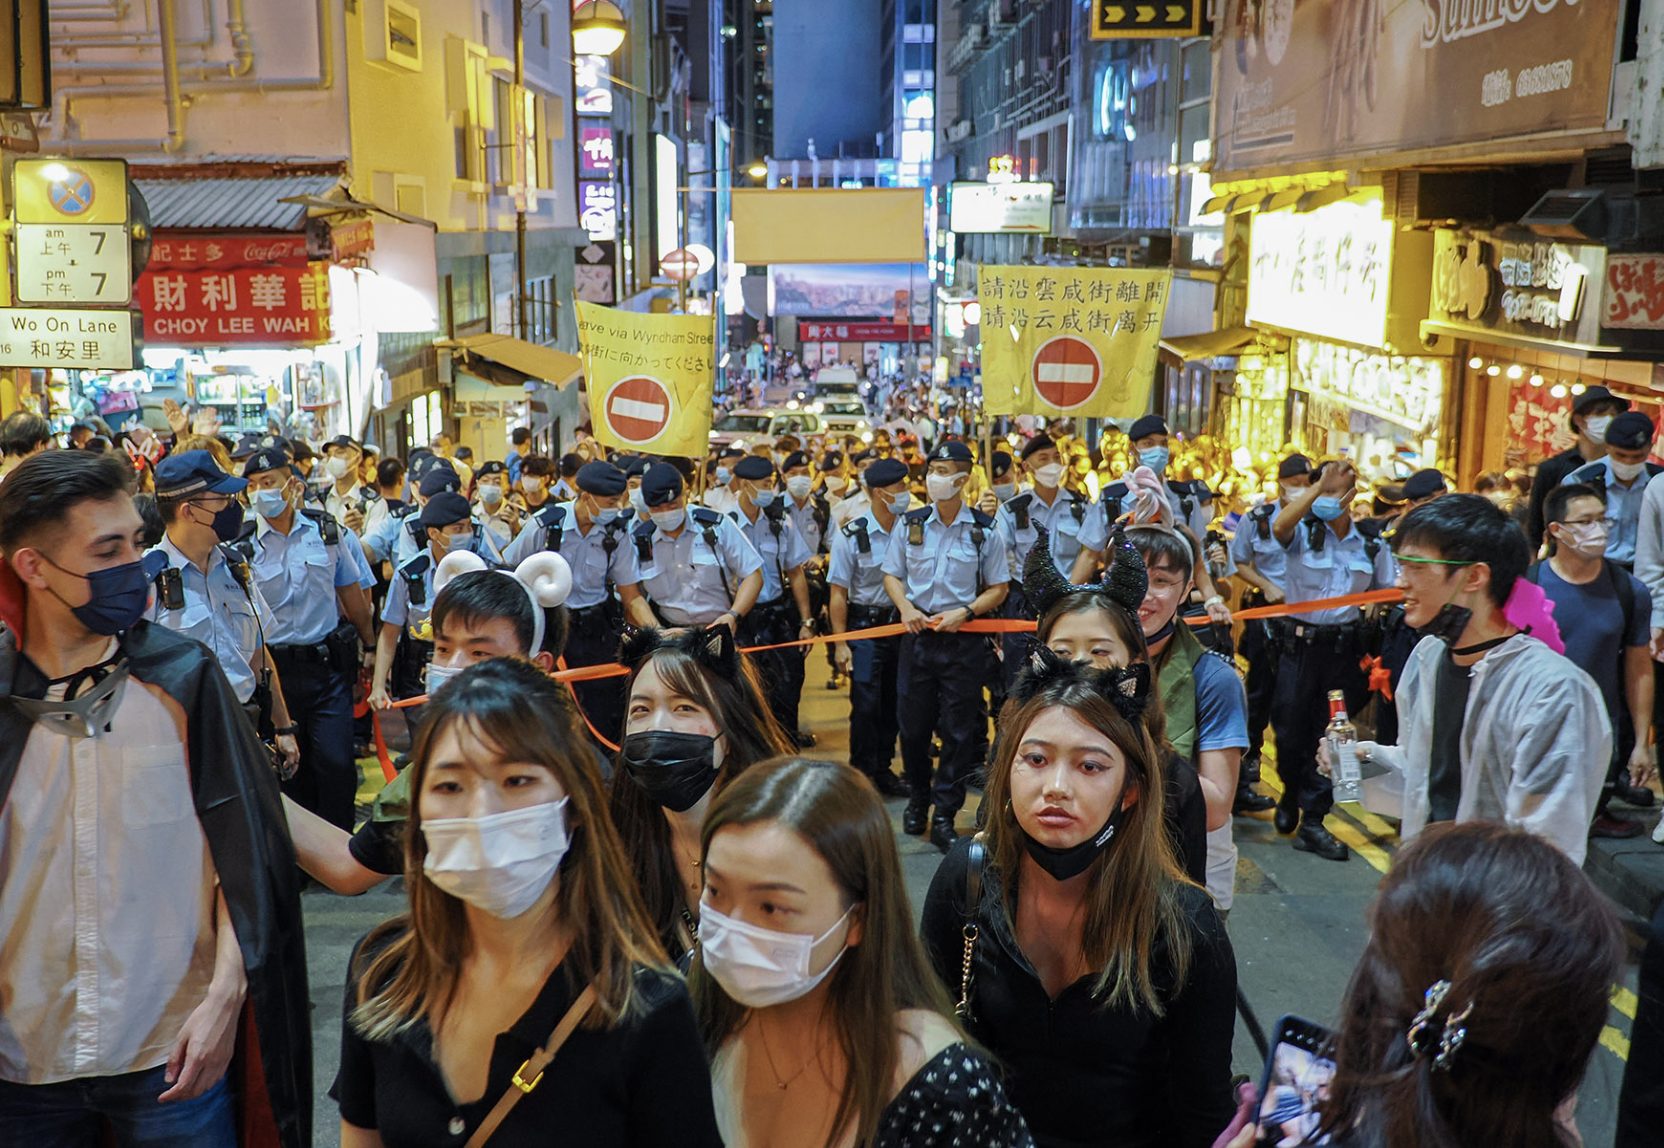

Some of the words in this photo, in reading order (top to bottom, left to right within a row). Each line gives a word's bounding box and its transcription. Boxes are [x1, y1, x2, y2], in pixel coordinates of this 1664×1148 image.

[40, 242, 72, 256] 上午
[46, 229, 65, 238] am
[90, 232, 107, 255] 7
[41, 283, 73, 297] 下午
[46, 269, 66, 279] pm
[90, 273, 107, 296] 7
[152, 274, 331, 313] 財利華記
[982, 276, 1166, 304] 請沿雲咸街離開
[11, 316, 38, 331] Wo
[46, 316, 70, 332] On
[78, 318, 118, 333] Lane
[154, 318, 209, 335] CHOY
[218, 318, 255, 334] LEE
[264, 318, 310, 335] WAH
[319, 317, 330, 331] K
[984, 305, 1159, 334] 请沿云咸街离开
[579, 320, 605, 334] ave
[609, 327, 628, 340] via
[633, 328, 685, 345] Wyndham
[687, 331, 714, 345] Stree
[30, 339, 102, 360] 和安里
